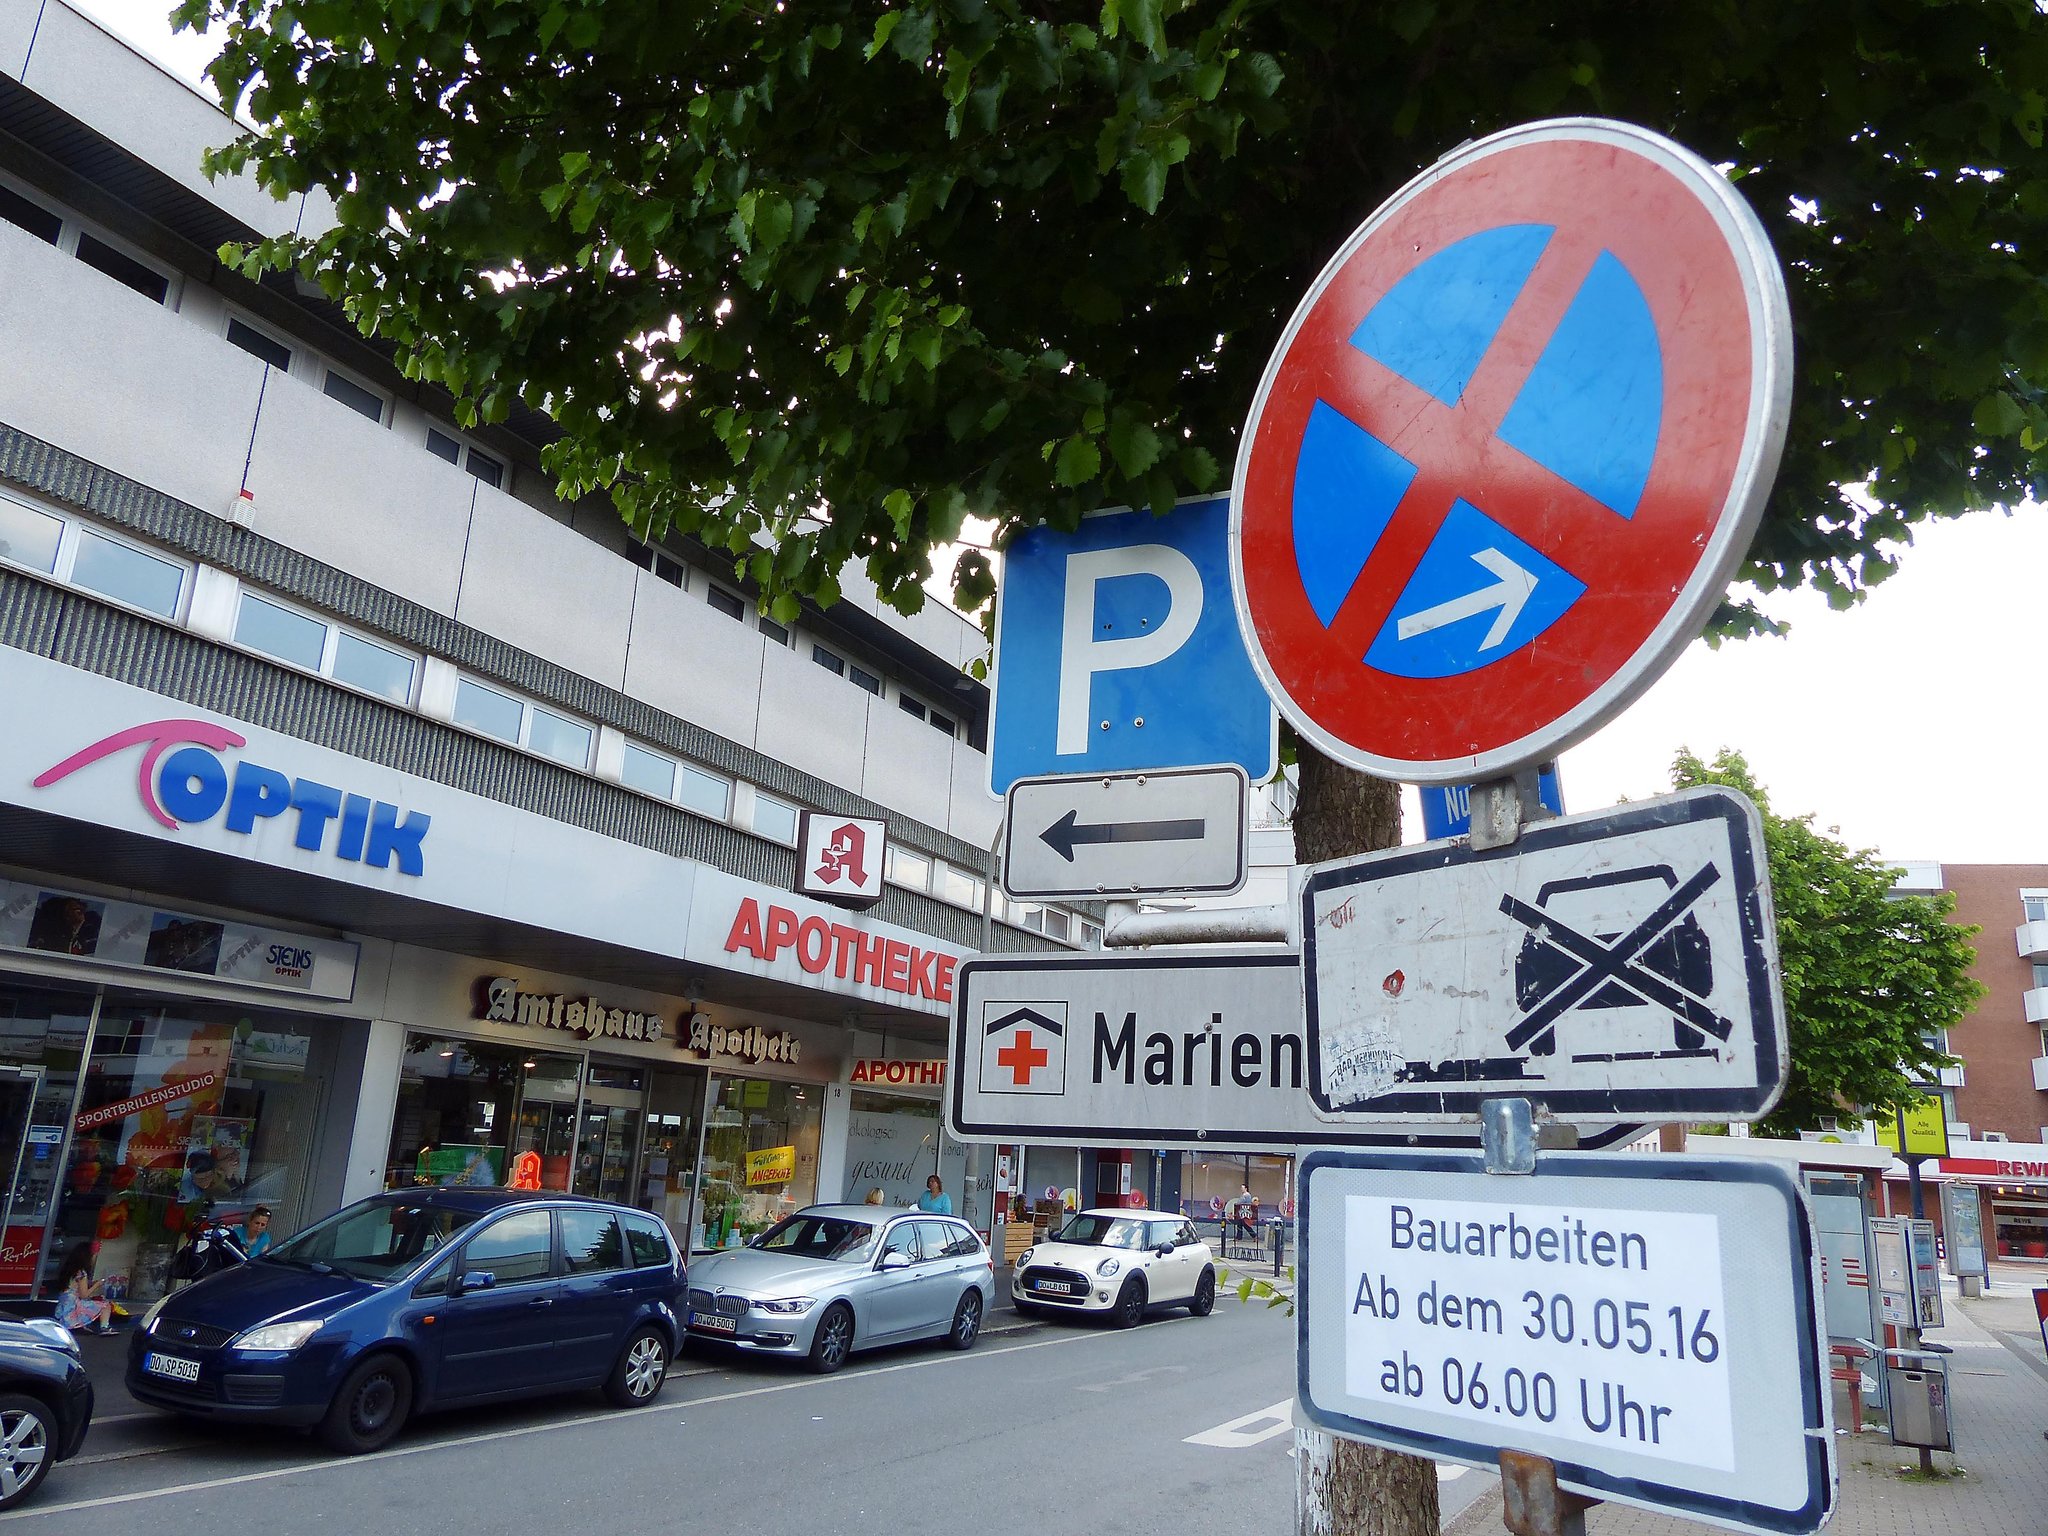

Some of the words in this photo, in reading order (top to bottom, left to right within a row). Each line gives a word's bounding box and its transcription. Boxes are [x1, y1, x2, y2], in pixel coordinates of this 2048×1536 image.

[1056, 543, 1204, 756] P
[160, 747, 432, 877] OPTIK
[1444, 784, 1476, 824] Nu
[265, 944, 312, 970] STEINS
[275, 967, 302, 977] OPTIK
[724, 897, 958, 1004] APOTHEKE
[485, 977, 664, 1041] Amtshaus
[688, 1012, 801, 1065] Apotheke
[1091, 1012, 1302, 1089] Marien
[77, 1073, 215, 1128] SPORTBRILLENSTUDIO
[1390, 1204, 1649, 1271] Bauarbeiten
[1353, 1272, 1400, 1320] Ab
[1417, 1281, 1504, 1335] dem
[1522, 1290, 1720, 1364] 30.05.16
[1380, 1350, 1424, 1399] ab
[1442, 1356, 1557, 1423] 06.00
[1581, 1378, 1673, 1445] Uhr
